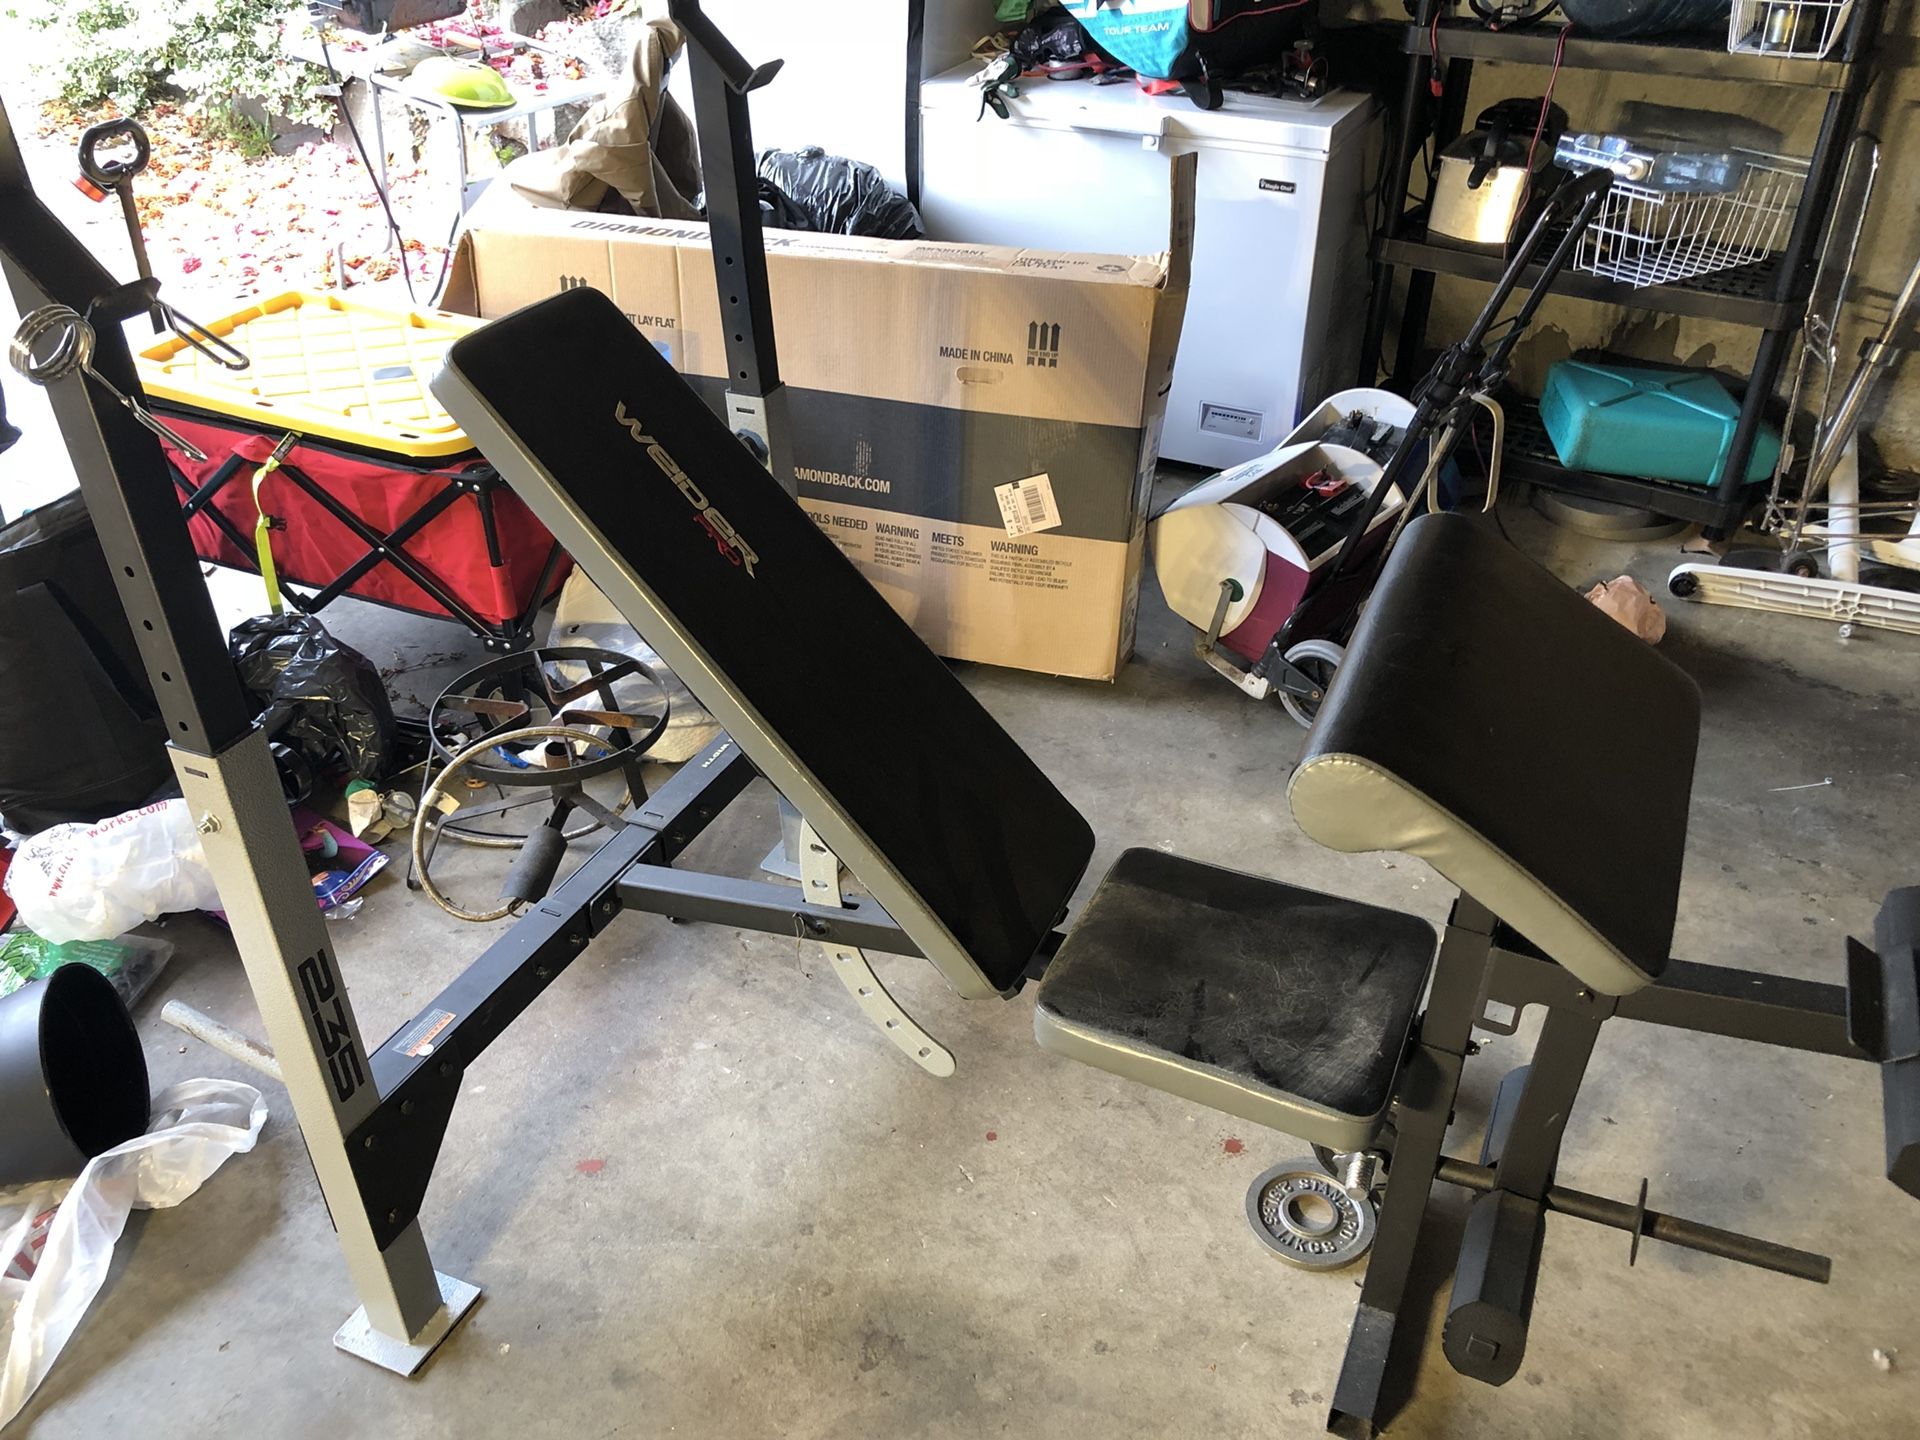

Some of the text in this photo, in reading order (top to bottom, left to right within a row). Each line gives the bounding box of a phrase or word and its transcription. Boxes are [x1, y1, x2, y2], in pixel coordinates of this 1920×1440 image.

[1104, 22, 1170, 36] TOUR TEAM
[625, 313, 676, 329] OT LAY FLAT
[939, 346, 1014, 365] MADE IN CHINA
[794, 466, 891, 494] AMONDBACK.COM
[807, 511, 868, 531] OOLS NEEDED
[875, 522, 920, 540] WARNING
[931, 531, 965, 547] MEETS
[990, 540, 1039, 556] WARNING
[297, 948, 366, 1103] 235
[1298, 1178, 1360, 1241] STANDARD
